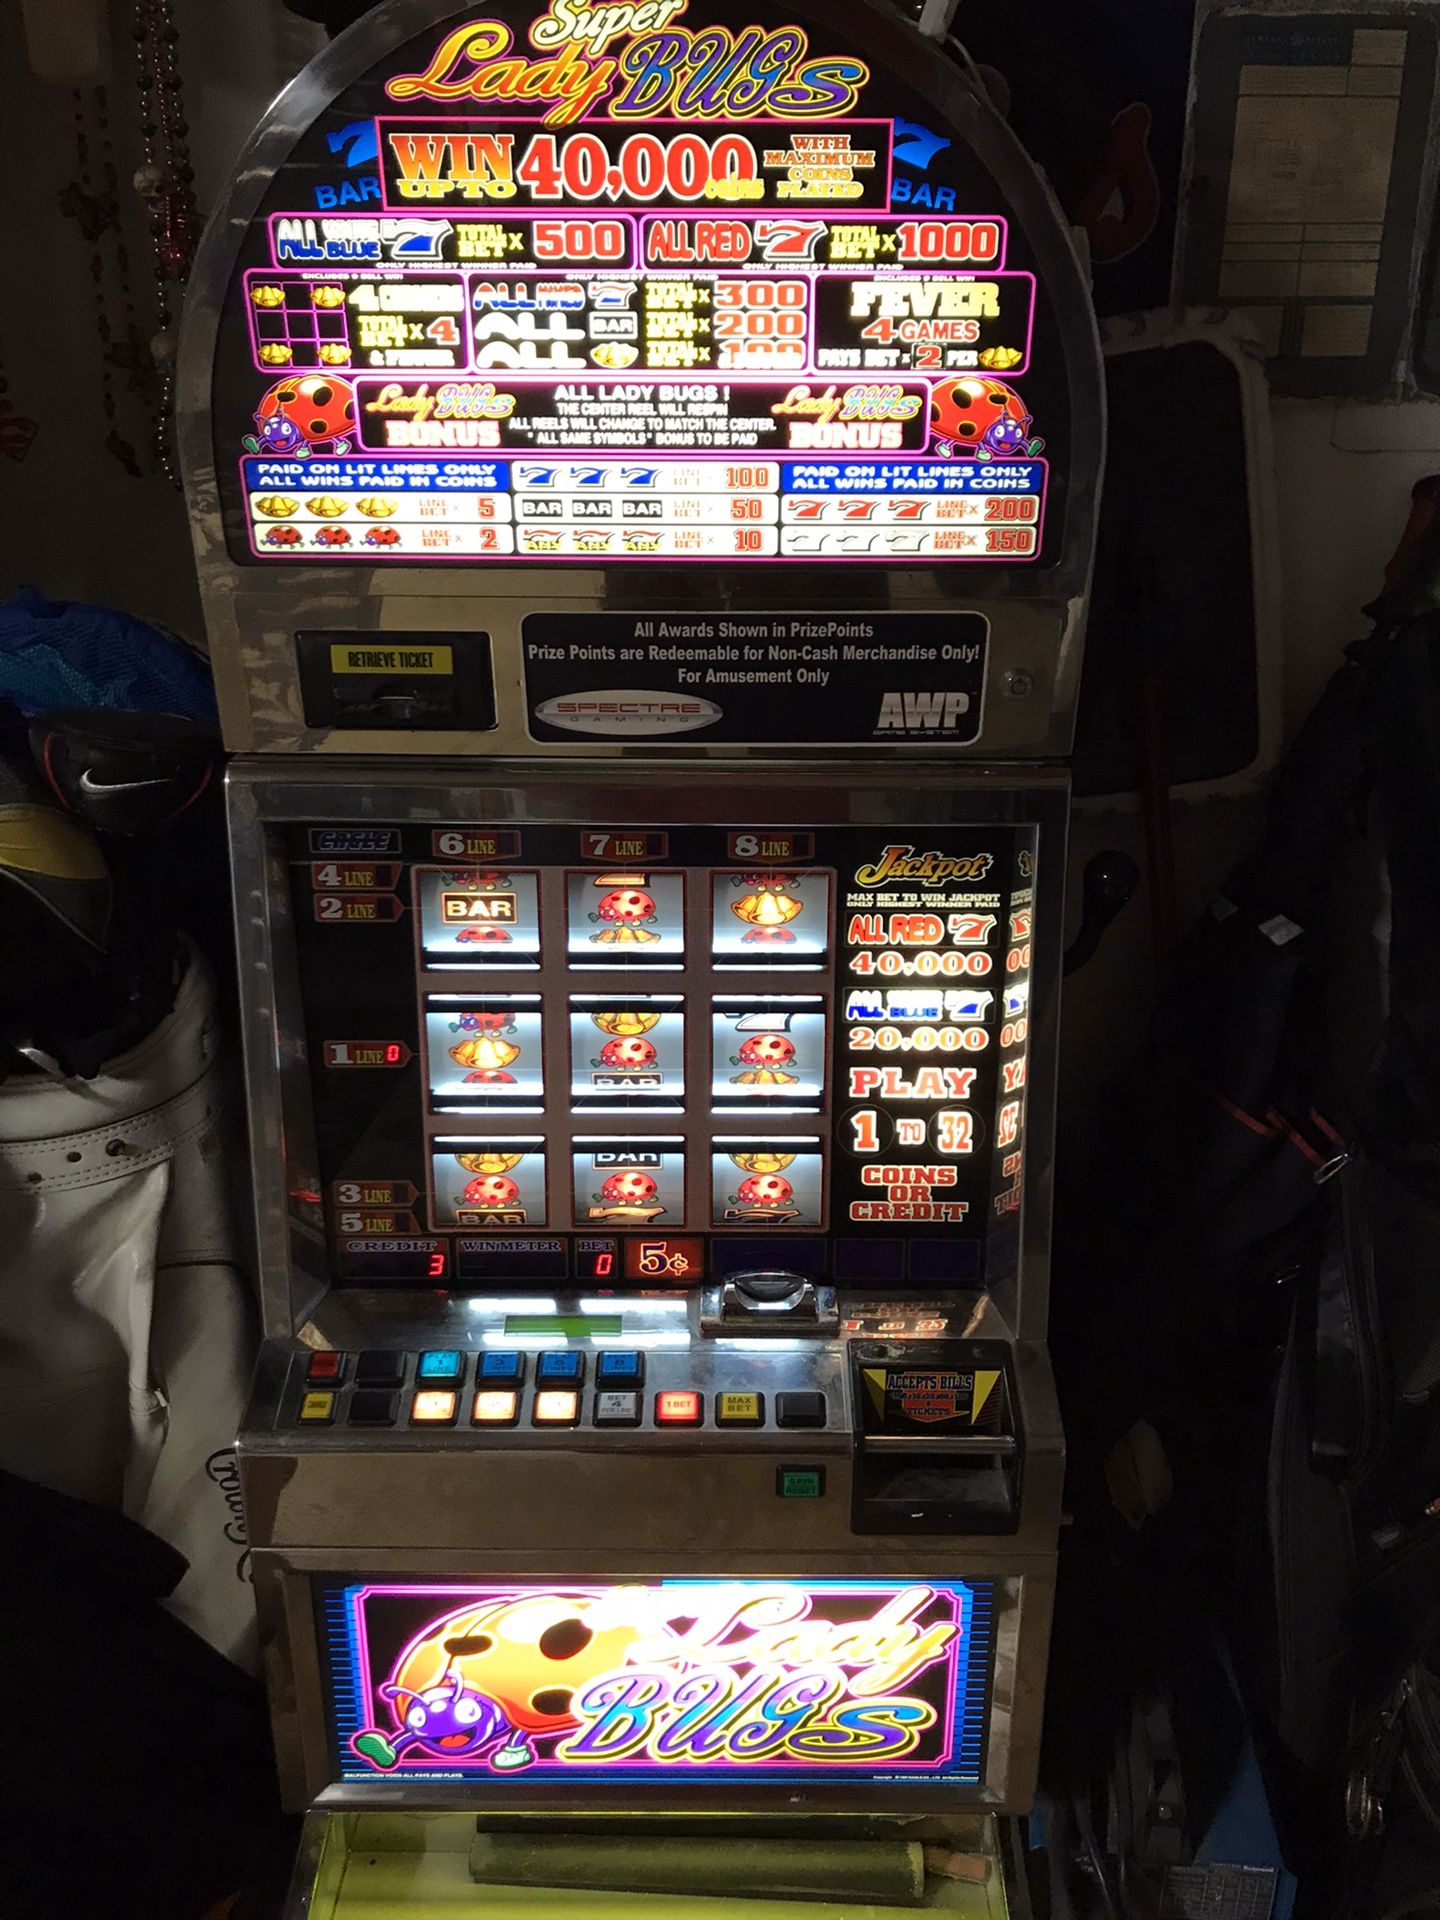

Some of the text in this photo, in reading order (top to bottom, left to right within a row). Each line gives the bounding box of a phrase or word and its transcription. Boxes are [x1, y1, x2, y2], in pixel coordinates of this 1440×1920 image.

[533, 0, 684, 57] Super
[386, 20, 617, 128] Lady
[791, 135, 850, 150] WITH
[389, 134, 515, 181] WIN
[517, 132, 757, 201] 40,000
[763, 151, 875, 166] MAXIMUM
[788, 167, 853, 181] COINS
[314, 177, 382, 210] BAR
[397, 180, 517, 198] UP TO
[776, 181, 864, 198] PLAYED
[891, 177, 957, 211] BAR
[326, 240, 381, 259] BLUE
[533, 220, 625, 260] 500
[649, 220, 828, 261] ALL RED 7
[897, 222, 999, 260] 1000
[713, 280, 807, 310] 300
[850, 281, 1000, 316] FEVER
[427, 316, 460, 345] 4
[713, 310, 807, 339] 200
[861, 316, 980, 344] 4 GAMES
[915, 345, 943, 367] 2
[366, 384, 434, 422] Lady
[554, 384, 718, 402] ALL LADY BUGS
[556, 402, 580, 416] THE
[581, 402, 626, 416] CENTER
[658, 402, 686, 416] WILL
[771, 385, 842, 424] Lady
[386, 420, 501, 447] BONUS
[508, 417, 531, 430] ALL
[569, 417, 597, 431] WILL
[598, 417, 646, 431] CHANGE
[647, 417, 664, 431] TO
[705, 417, 728, 431] THE
[696, 432, 758, 445] TO PAID
[788, 422, 903, 449] BONUS
[258, 464, 497, 476] PAID ON LIT LINES ONLY
[725, 467, 769, 488] 100
[793, 466, 1032, 478] PAID ON LIT LINES ONLY
[259, 476, 497, 488] ALL WINS PAID COINS
[793, 478, 1031, 489] ALL WINS PAID IN COINS
[477, 495, 496, 519] 5
[523, 501, 562, 516] BAR
[573, 501, 612, 516] BAR
[622, 501, 662, 516] BAR
[730, 498, 762, 520] 50
[984, 497, 1036, 521] 200
[479, 527, 500, 550] 2
[734, 529, 763, 552] 10
[985, 528, 1032, 552] 150
[634, 622, 873, 639] All Awards Shown in PrizePoints
[348, 651, 434, 668] RETRIEVE TICKET
[528, 645, 979, 663] Prize Points are Redeemable for Non-Cash Merchandise Only!
[678, 668, 830, 687] For Amusement Only
[557, 703, 701, 713] SPECTRE
[877, 692, 970, 728] AWP
[439, 833, 496, 855] 6 LINE
[589, 834, 643, 856] 7 LINE
[734, 834, 790, 857] 8 LINE
[318, 865, 373, 886] 4 LINE
[855, 845, 994, 888] Jackpot
[847, 893, 1000, 902] MAX BET TO WIN JACKPOT
[320, 898, 375, 919] 2 LINE
[446, 899, 512, 918] BAR
[848, 914, 997, 945] ALL RED 7
[330, 1043, 400, 1064] 1 LINE 0
[849, 1067, 977, 1099] PLAY
[850, 1110, 973, 1153] 1 TO 32
[861, 1165, 957, 1186] COINS
[339, 1184, 392, 1203] 3 LINE
[888, 1185, 932, 1202] OR
[850, 1202, 968, 1221] CREDIT
[340, 1213, 393, 1232] 5 LINE
[346, 1240, 614, 1251] CREDIT BET
[428, 1254, 612, 1275] 3 0
[639, 1242, 689, 1276] 5¢
[887, 1375, 973, 1391] ACCEPTS BILLS
[727, 1396, 752, 1404] MAX
[727, 1404, 752, 1412] BET
[626, 1585, 960, 1697] Lady
